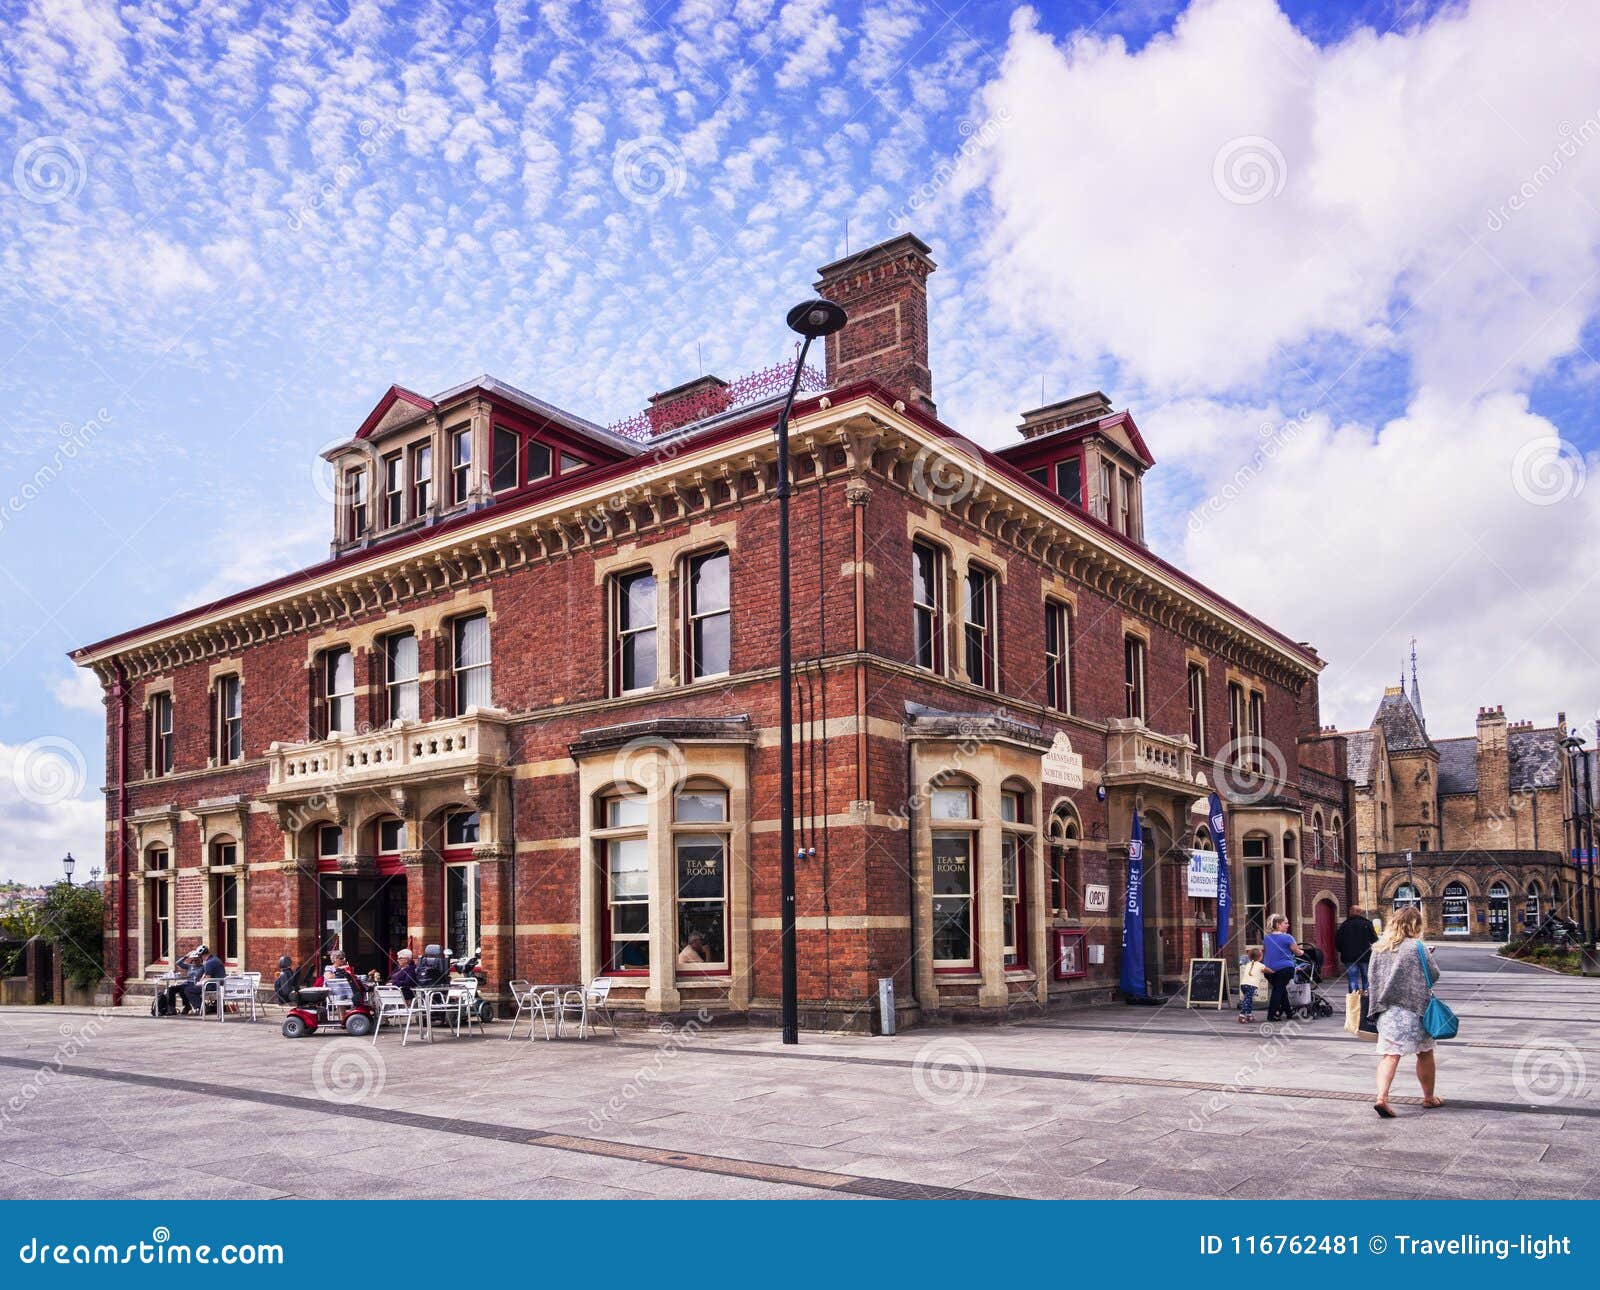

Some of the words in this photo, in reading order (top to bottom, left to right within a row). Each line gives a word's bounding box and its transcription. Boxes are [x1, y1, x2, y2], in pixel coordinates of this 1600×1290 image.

[687, 860, 702, 868] TEA
[937, 856, 953, 864] TEA
[687, 868, 716, 876] ROOM
[937, 864, 966, 872] ROOM
[1089, 890, 1105, 905] OPEN
